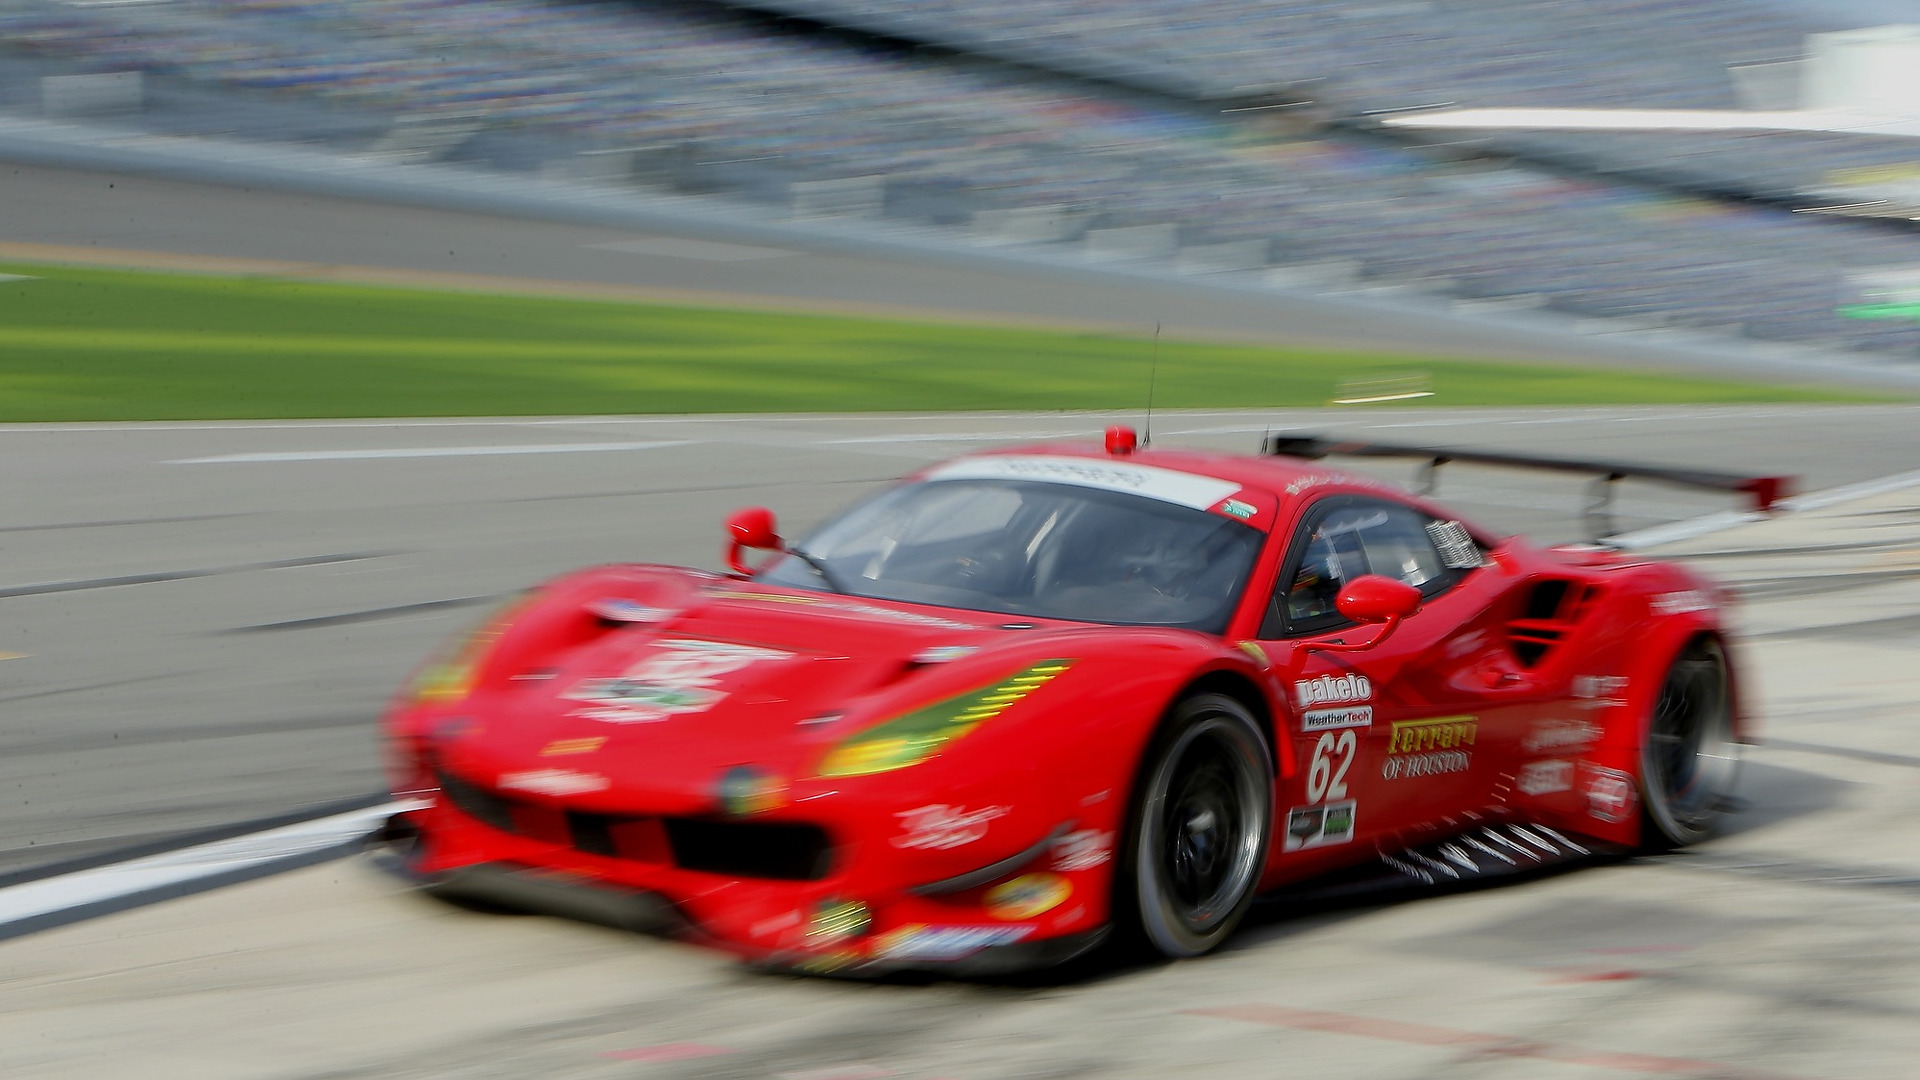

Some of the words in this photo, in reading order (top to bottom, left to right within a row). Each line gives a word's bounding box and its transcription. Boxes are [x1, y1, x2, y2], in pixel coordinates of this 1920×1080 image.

[1295, 673, 1371, 708] pakelo
[1307, 711, 1370, 725] WeatherTech
[1308, 730, 1357, 805] 62
[1382, 757, 1404, 780] OF
